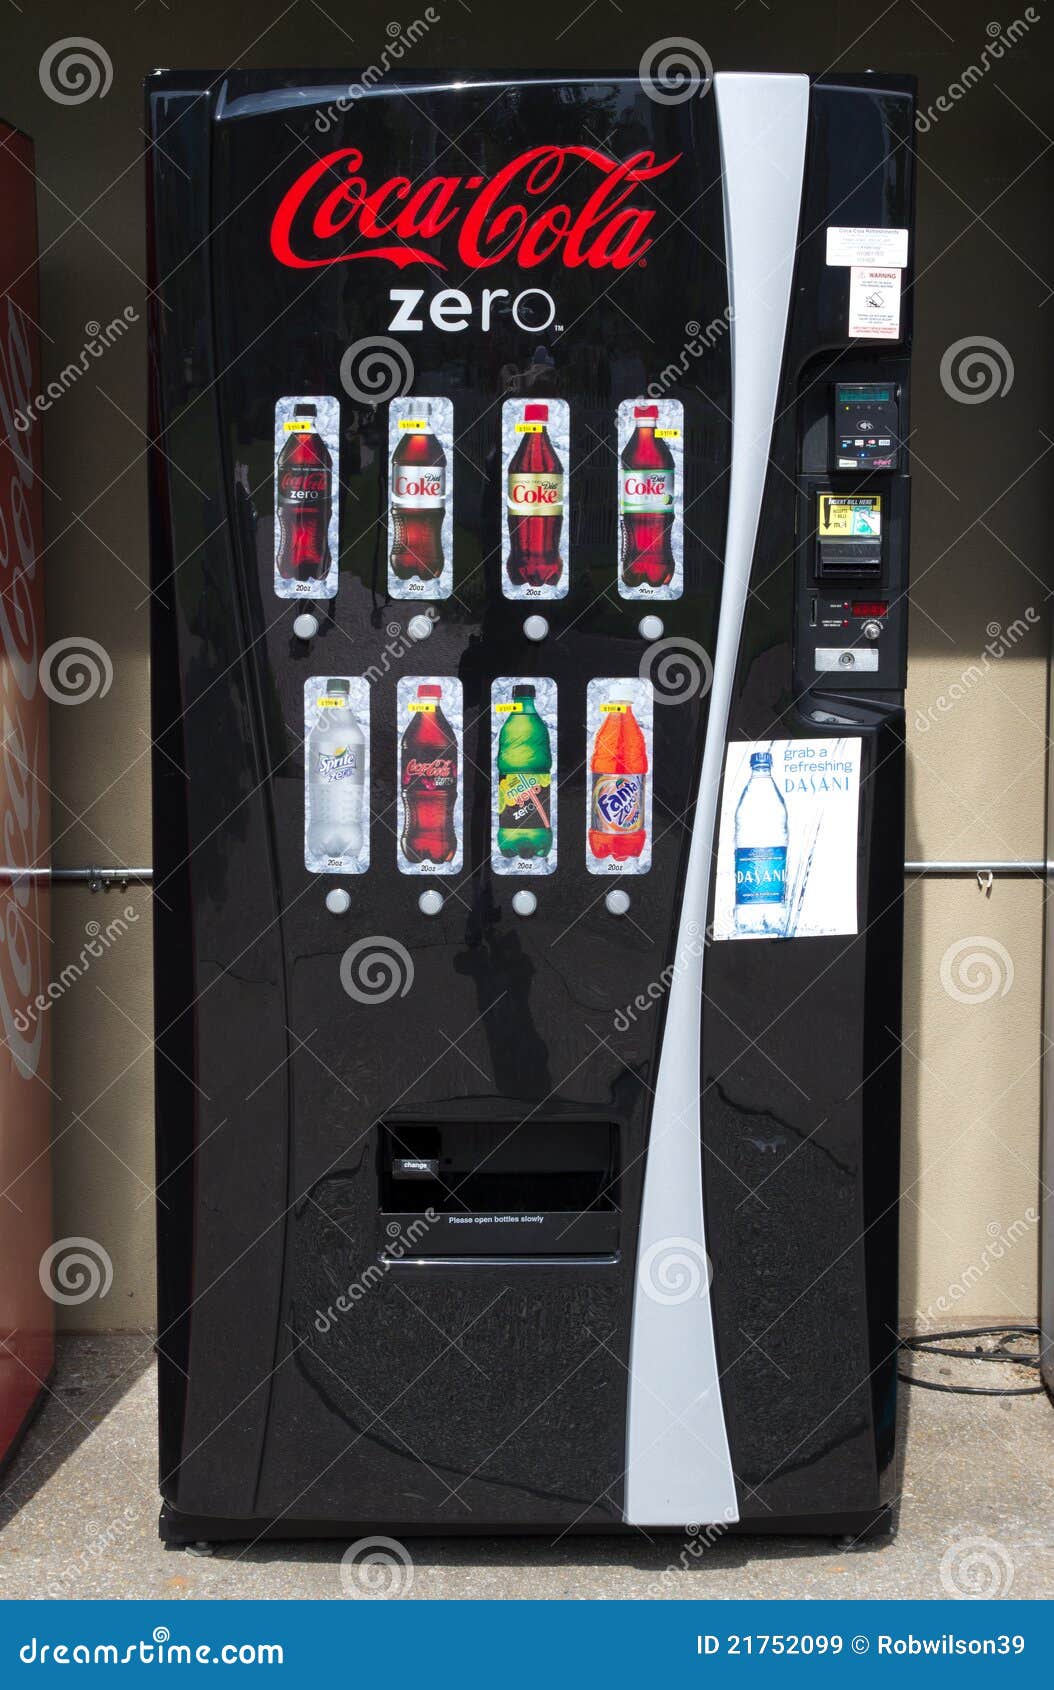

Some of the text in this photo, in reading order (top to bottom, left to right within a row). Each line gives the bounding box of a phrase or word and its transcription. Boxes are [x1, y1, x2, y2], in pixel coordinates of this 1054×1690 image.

[270, 145, 683, 271] Coca-Cola
[387, 288, 556, 333] zero
[290, 490, 318, 499] zero
[395, 476, 440, 496] Coke
[513, 484, 558, 504] Coke
[625, 478, 665, 496] Coke
[295, 584, 311, 592] 20oz
[784, 747, 828, 761] grab a
[319, 754, 354, 774] Sprite
[784, 760, 853, 774] refreshing
[507, 774, 537, 799] mello
[785, 774, 849, 794] DASANI
[598, 782, 638, 822] Fanta
[513, 803, 536, 820] zero
[737, 869, 785, 885] DASANI
[403, 1161, 428, 1170] change
[448, 1215, 544, 1225] Please open bottles slowly
